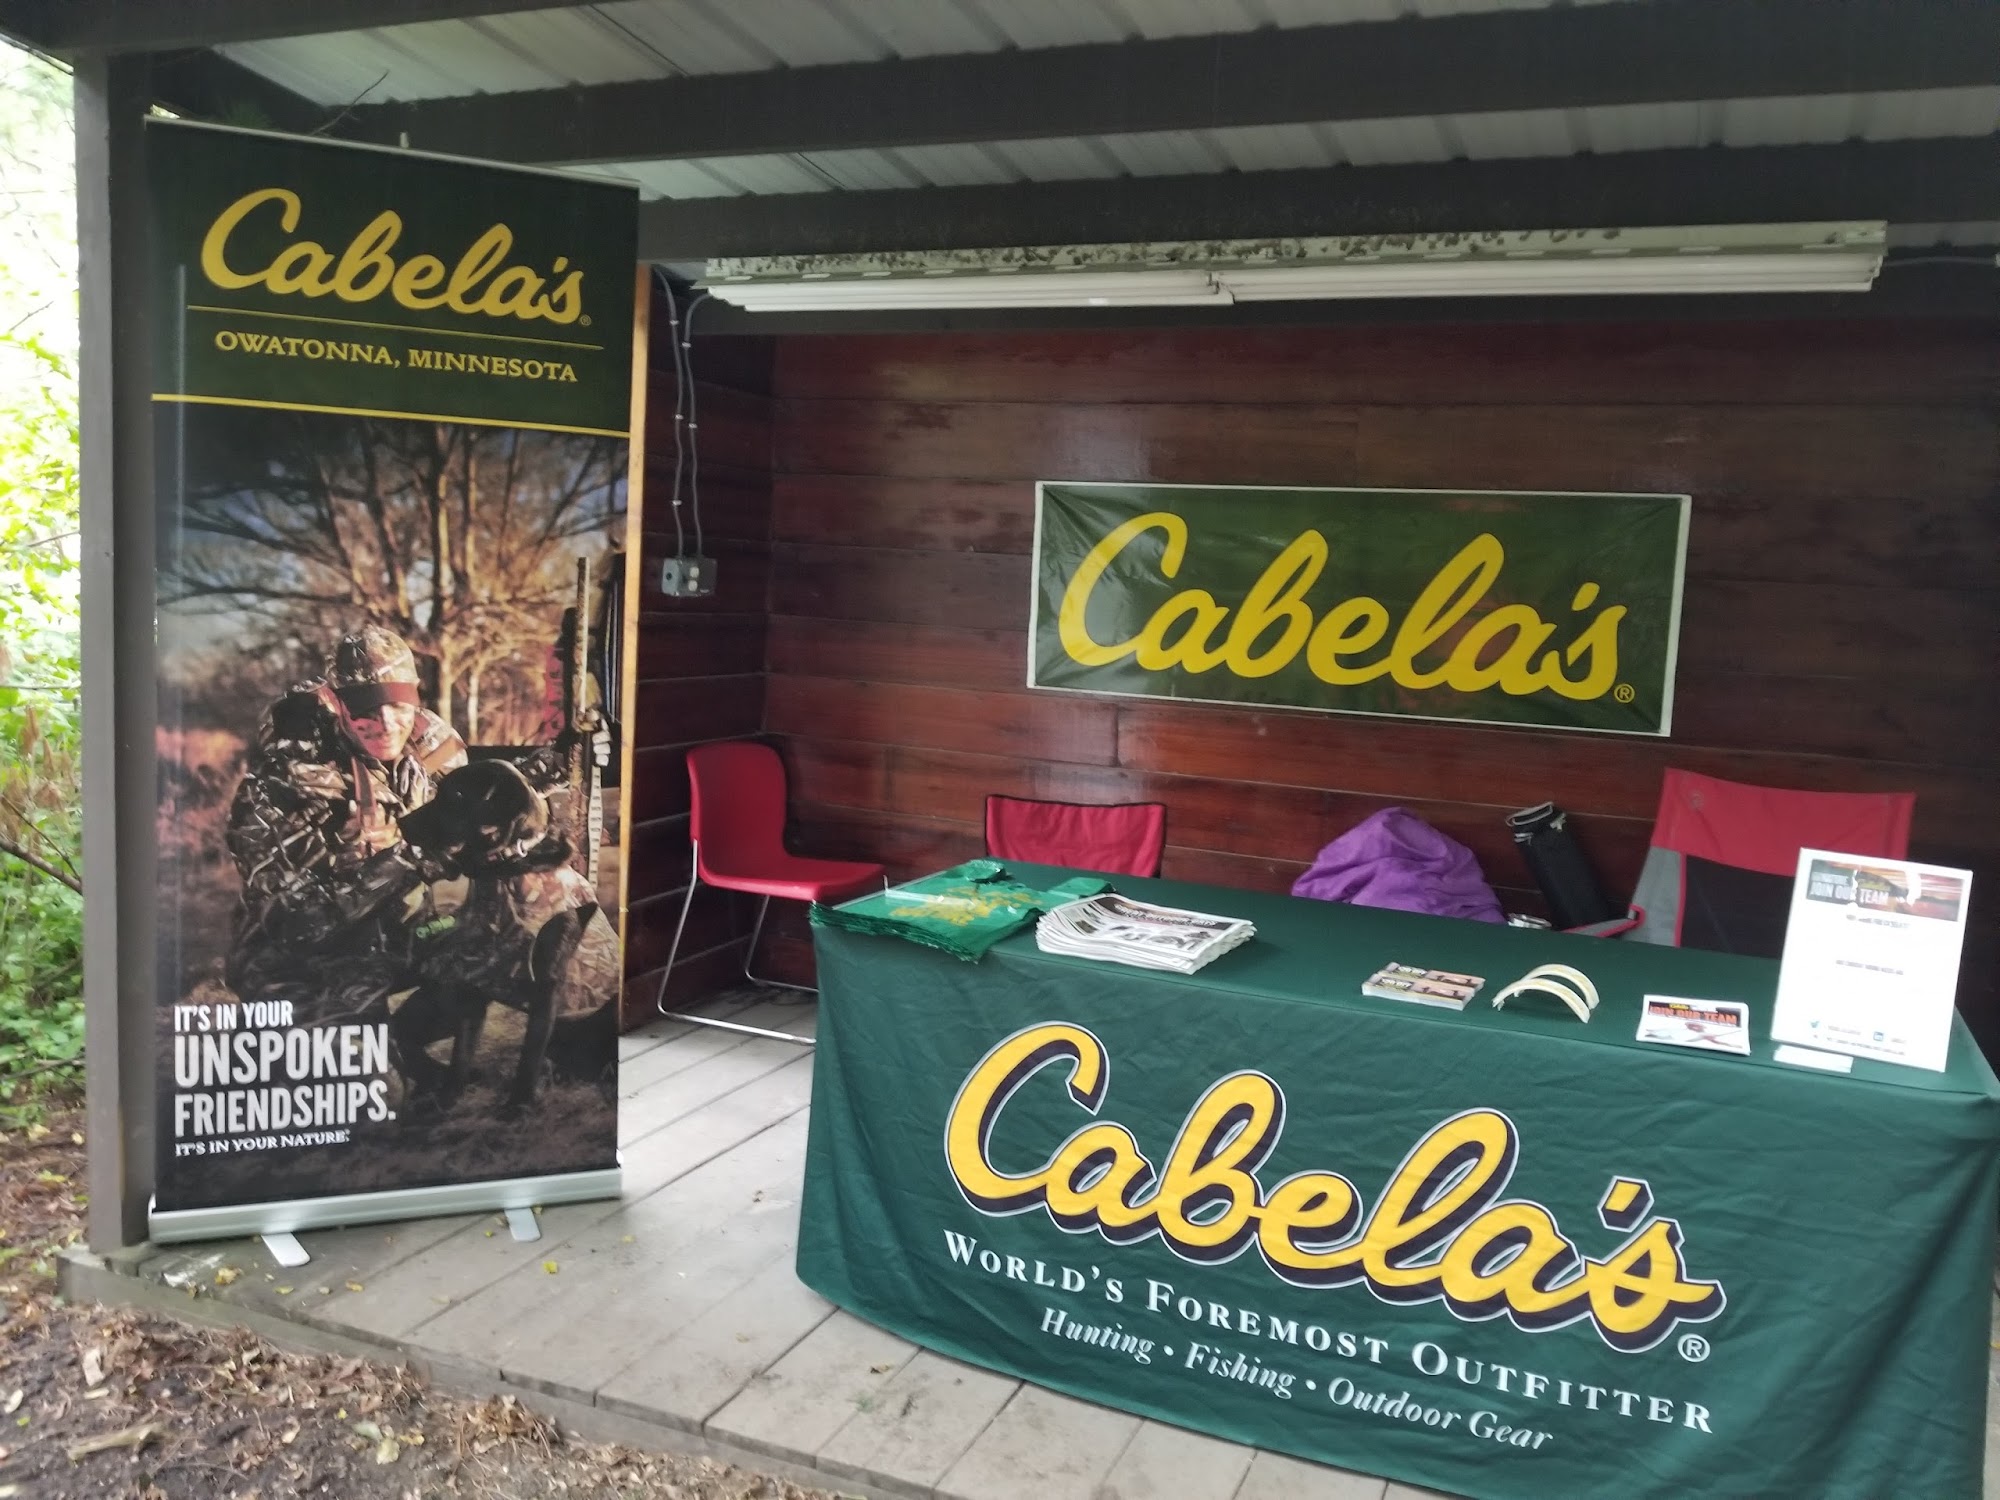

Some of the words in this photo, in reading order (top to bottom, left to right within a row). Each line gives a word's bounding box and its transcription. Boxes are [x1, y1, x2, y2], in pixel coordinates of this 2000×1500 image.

[201, 188, 584, 325] Cabela's
[215, 330, 401, 369] OWATONNA,
[408, 349, 578, 382] MINNESOTA
[1058, 512, 1627, 700] Cabela's
[1860, 888, 1890, 905] TEAM
[174, 1004, 211, 1032] IT'S
[216, 1003, 237, 1030] IN
[242, 1000, 294, 1029] YOUR
[1703, 1012, 1738, 1026] TEAM
[174, 1023, 389, 1089] UNSPOKEN
[174, 1079, 397, 1138] FRIENDSHIPS.
[175, 1142, 206, 1157] IT'S
[209, 1139, 230, 1154] IN
[231, 1135, 278, 1152] YOUR
[943, 1020, 1727, 1354] Cabela's
[943, 1229, 1125, 1304] WORLD'S
[1145, 1278, 1389, 1365] FOREMOST
[1411, 1341, 1713, 1434] OUTFITTER
[1040, 1306, 1155, 1366] Hunting
[1184, 1341, 1297, 1400] Fishing
[1328, 1376, 1462, 1430] Outdoor
[1468, 1410, 1554, 1451] Gear
